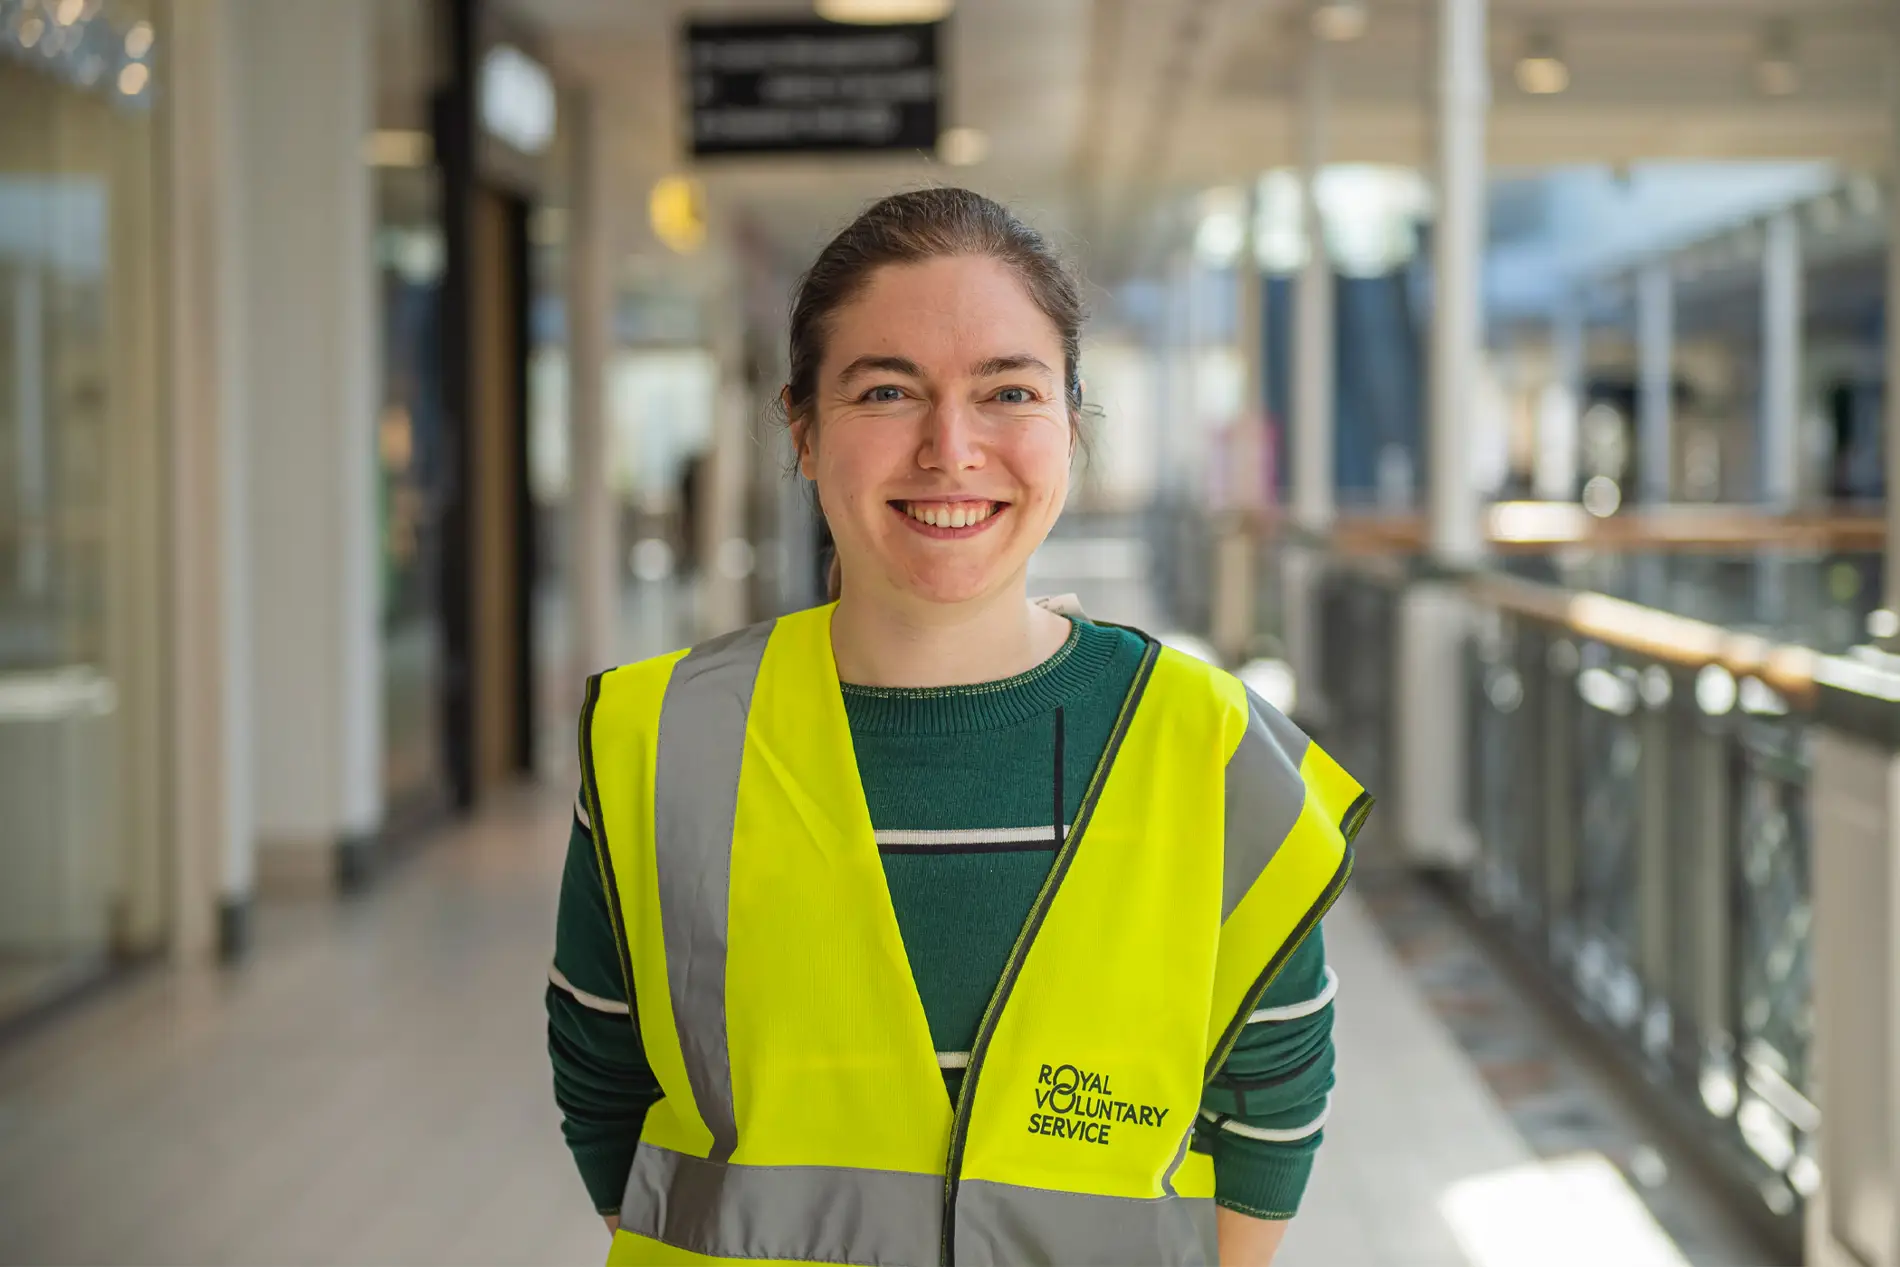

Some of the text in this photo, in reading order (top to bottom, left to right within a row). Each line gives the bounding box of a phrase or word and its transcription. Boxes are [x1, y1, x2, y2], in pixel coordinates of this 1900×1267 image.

[1038, 1064, 1112, 1095] ROYAL
[1035, 1083, 1169, 1127] VOLUNTARY
[1028, 1113, 1111, 1144] SERVICE
